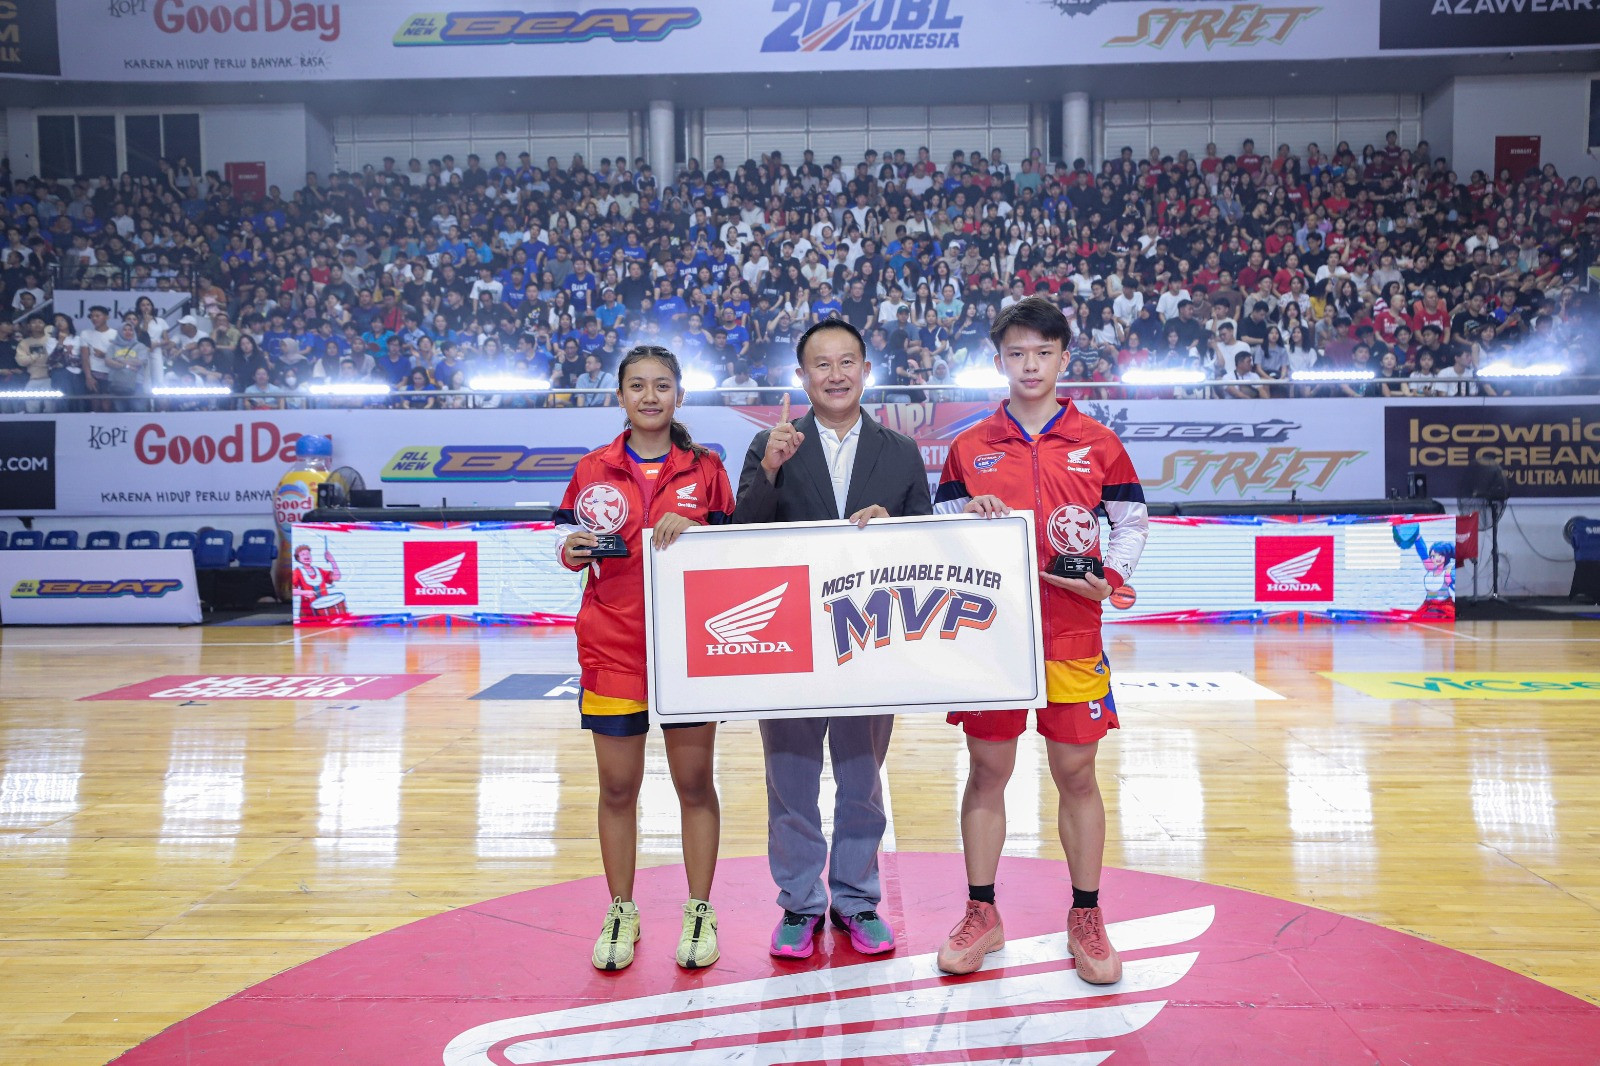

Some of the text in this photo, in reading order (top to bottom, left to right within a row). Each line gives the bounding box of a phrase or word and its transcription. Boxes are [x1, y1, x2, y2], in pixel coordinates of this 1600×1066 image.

[153, 0, 257, 33] Good
[264, 0, 340, 41] Day
[411, 18, 436, 26] ALL
[1103, 4, 1322, 50] STREET
[404, 27, 437, 36] NEW
[850, 33, 960, 50] INDONESIA
[124, 57, 325, 70] KARENA HIDUP PERLU BANYAK RASA
[88, 425, 128, 449] Kopi
[134, 423, 244, 465] Good
[401, 452, 428, 460] ALL
[1410, 447, 1469, 466] ICE
[393, 461, 430, 471] NEW
[1142, 446, 1366, 496] STREET
[1515, 469, 1567, 485] ULTRA
[101, 490, 275, 503] KARENA HIDUP PERLU BANYA
[822, 564, 1001, 597] MOST VALUABLE PLAYER
[1267, 583, 1322, 592] HONDA
[415, 587, 467, 596] HONDA
[823, 586, 997, 666] MVP
[706, 641, 793, 656] HONDA
[149, 687, 355, 698] CREAM
[1088, 700, 1102, 720] 5
